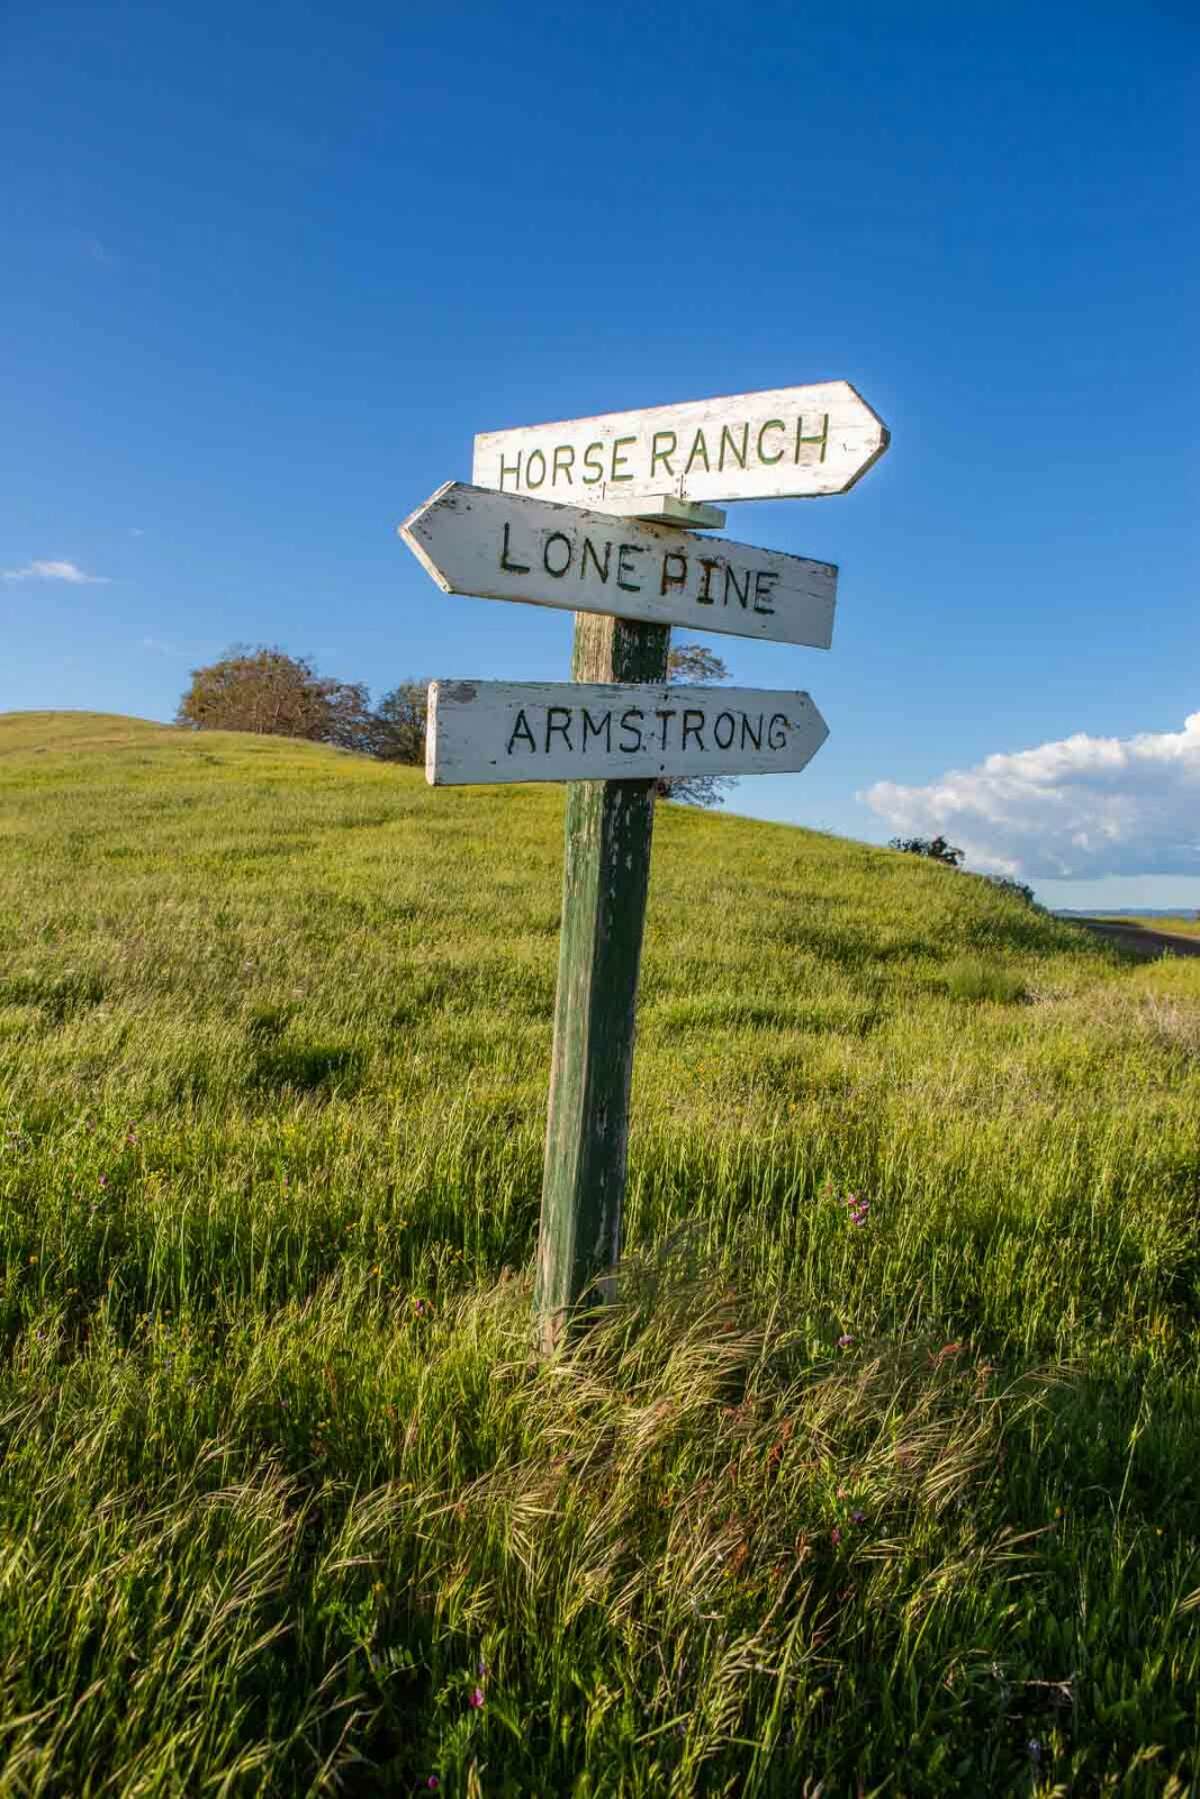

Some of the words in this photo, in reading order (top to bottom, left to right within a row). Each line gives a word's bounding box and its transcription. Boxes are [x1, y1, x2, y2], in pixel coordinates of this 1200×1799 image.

[500, 435, 637, 491] HORSE
[650, 413, 830, 477] RANCH
[501, 522, 644, 592] LONE
[660, 552, 780, 615] PINE
[506, 706, 790, 755] ARMSTRONG
